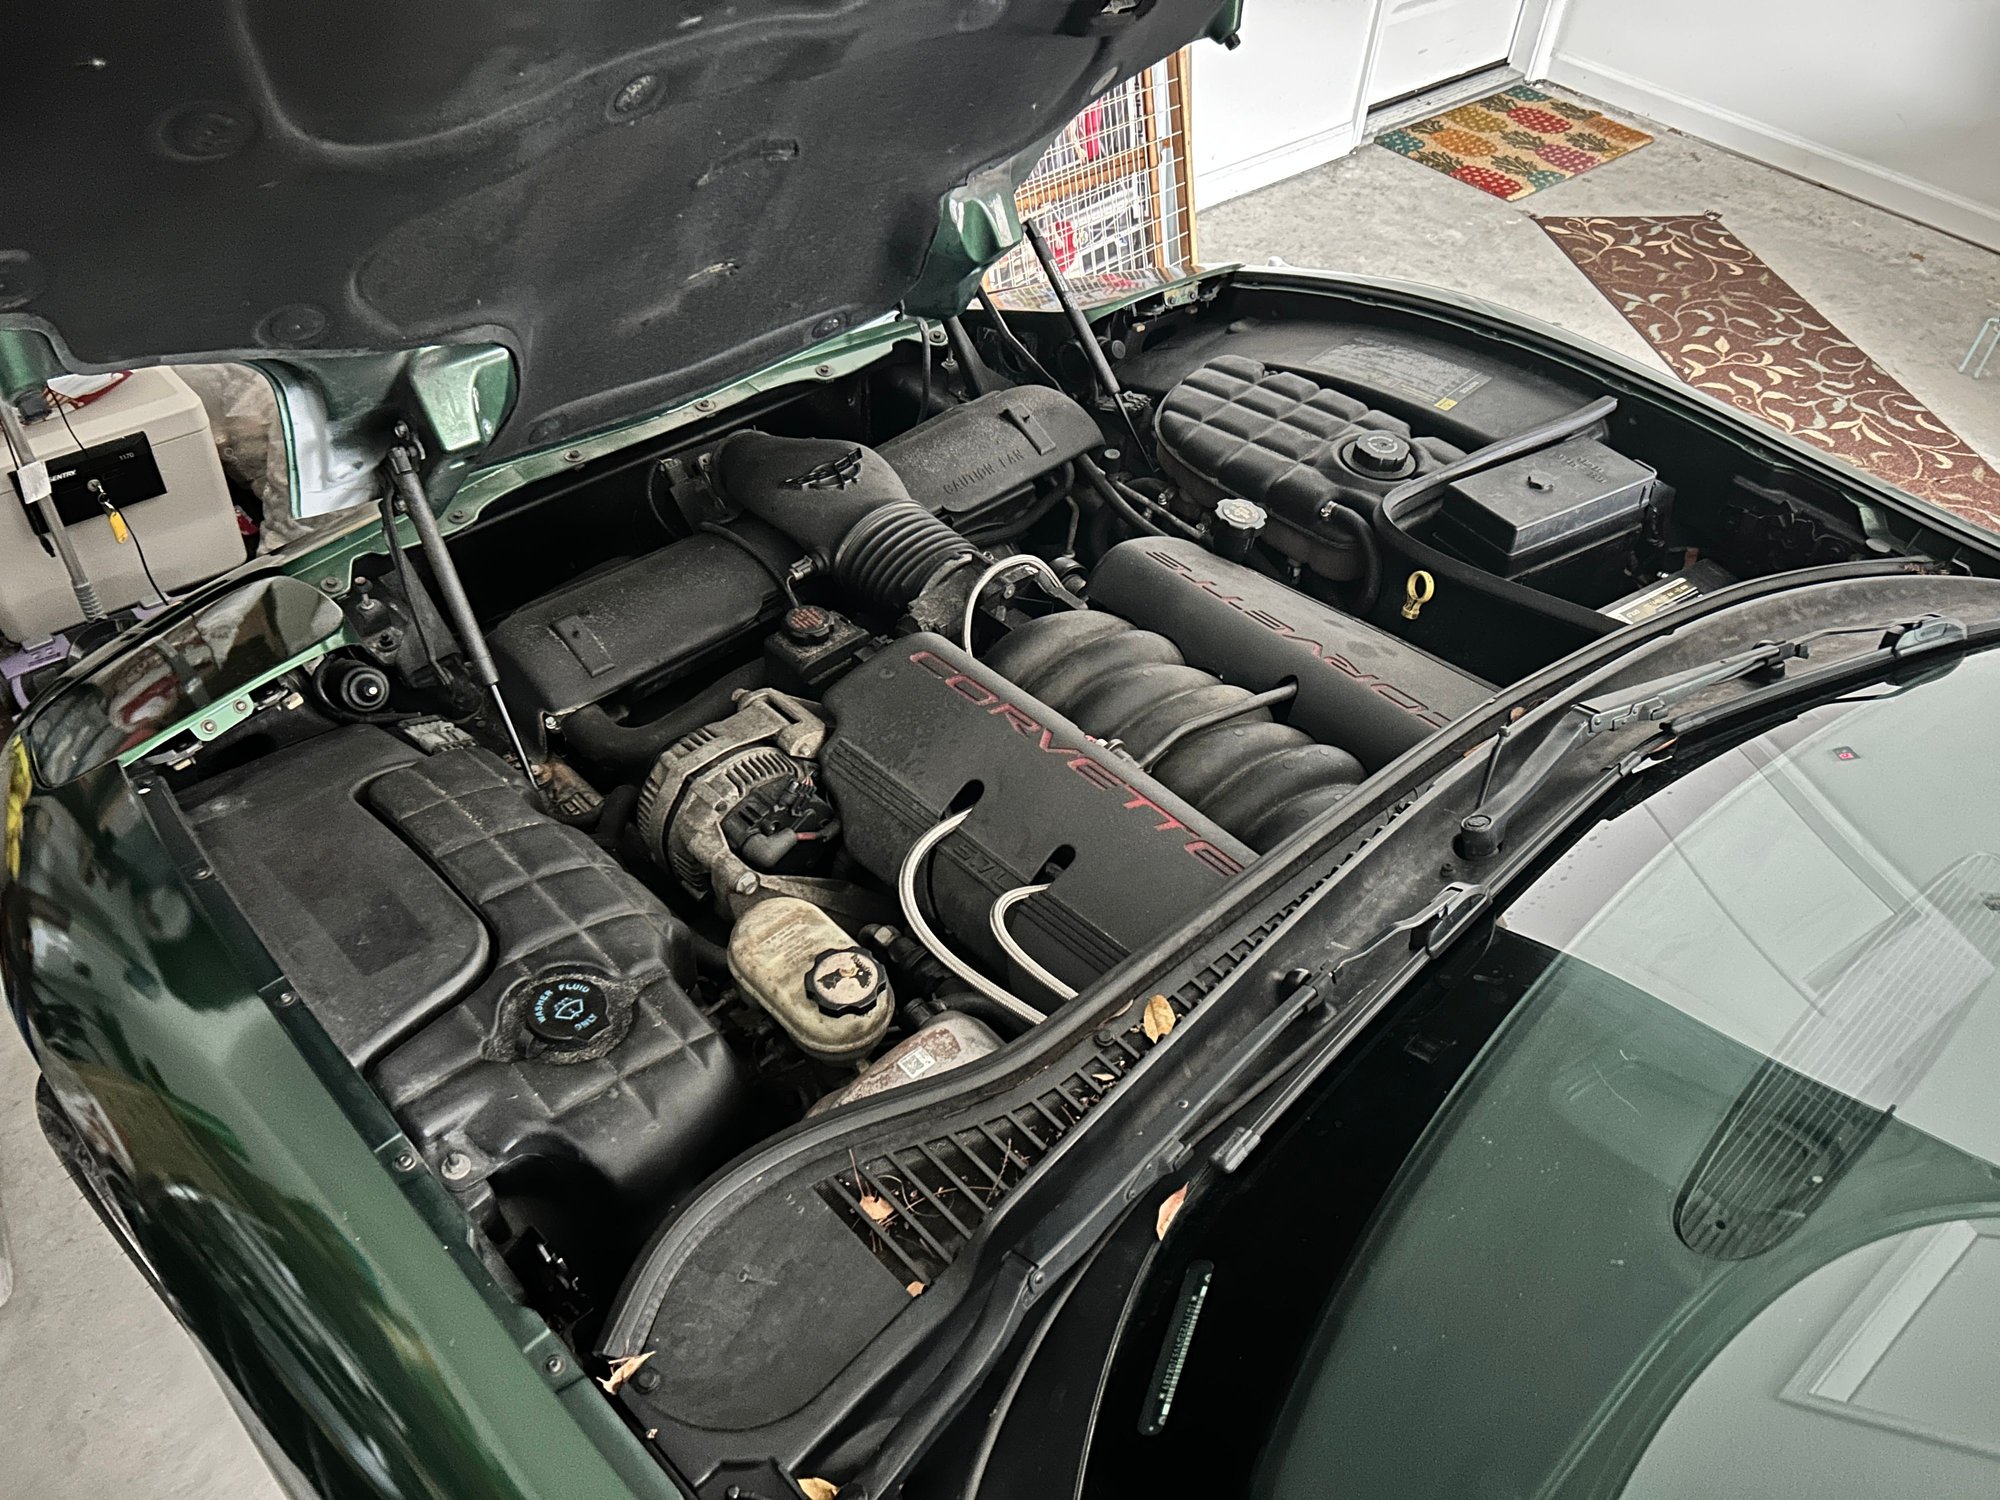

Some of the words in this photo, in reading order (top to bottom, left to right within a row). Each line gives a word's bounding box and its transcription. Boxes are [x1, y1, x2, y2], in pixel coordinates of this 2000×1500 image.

[909, 650, 1246, 877] CORVETTE
[534, 989, 554, 1025] WASHER
[558, 983, 591, 993] FLUID
